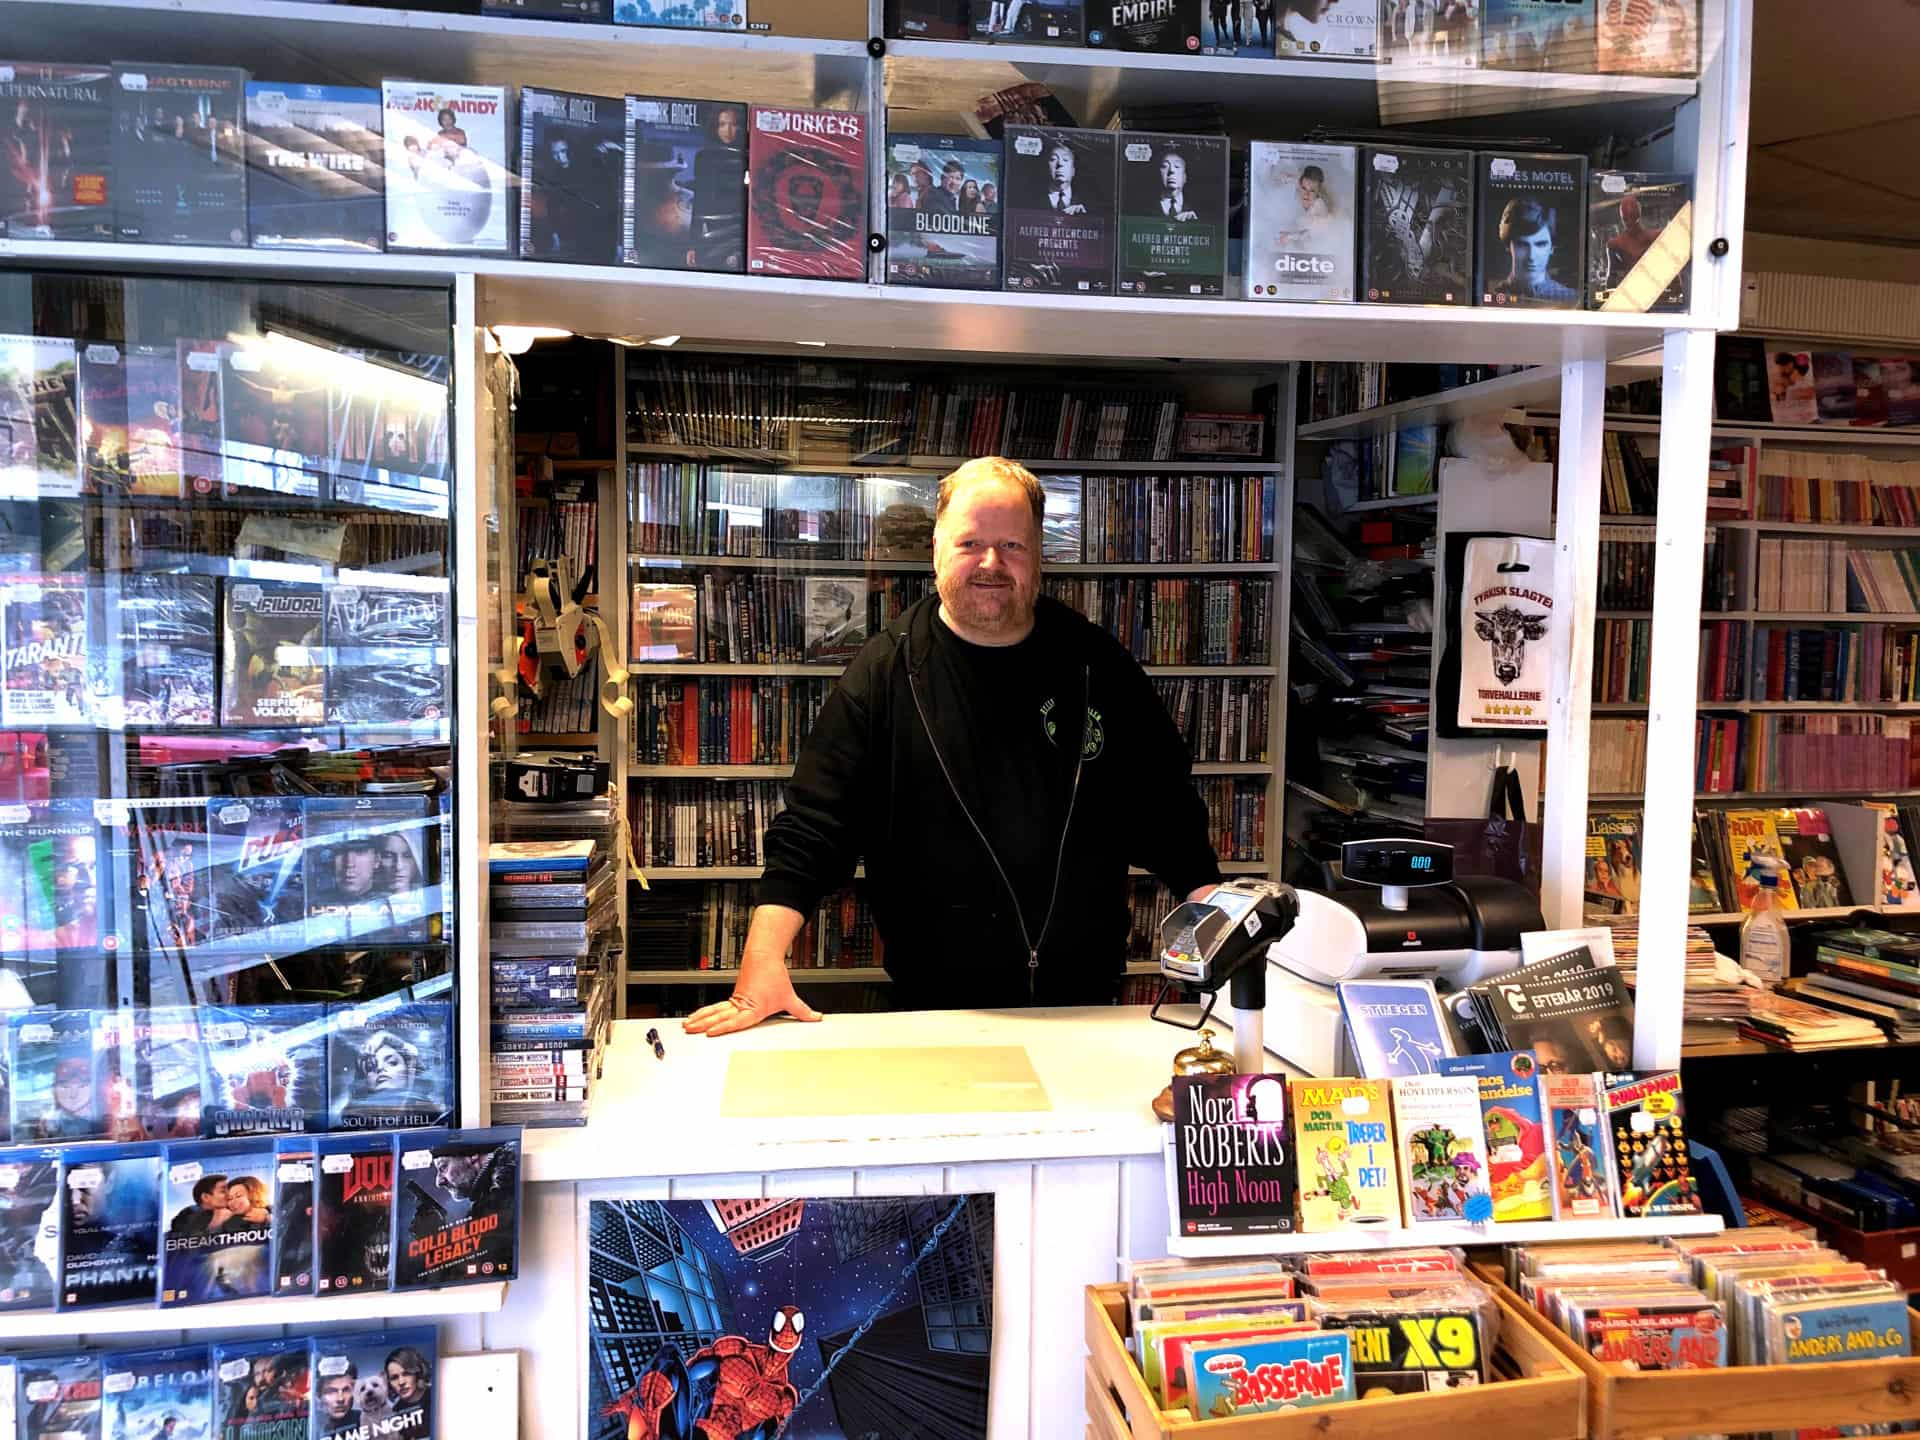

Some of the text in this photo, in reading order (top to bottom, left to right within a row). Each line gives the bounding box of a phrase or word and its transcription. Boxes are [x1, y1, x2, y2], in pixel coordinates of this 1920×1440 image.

[1112, 0, 1176, 26] EMPIRE
[1326, 13, 1377, 25] CROWN
[0, 84, 98, 101] UPERNATURAL
[448, 100, 498, 115] MINDY
[569, 100, 598, 123] ANGEL
[670, 103, 700, 126] ANGEL
[783, 111, 859, 137] MONKEYS
[1401, 159, 1464, 169] KINGS
[1532, 171, 1575, 184] MOTEL
[915, 211, 992, 236] BLOODLINE
[1019, 226, 1049, 238] ALFRED
[1038, 238, 1079, 250] PRESENTS
[1131, 233, 1210, 247] ALFRED HITCHCOCK
[1151, 245, 1190, 256] PRESENTS
[1275, 254, 1335, 273] dicte
[19, 377, 60, 395] THE
[1531, 982, 1614, 1009] EFTERÅR 2019
[1477, 1076, 1504, 1085] aos
[1480, 1082, 1533, 1100] andelse
[1608, 1074, 1679, 1107] RUMSPION
[1189, 1084, 1236, 1126] Nora
[1310, 1110, 1332, 1121] DON
[215, 1107, 305, 1135] SHOCKER
[343, 1114, 431, 1128] SOUTH OF HELL
[1303, 1121, 1344, 1132] MARTIN
[1183, 1122, 1285, 1169] ROBERTS
[343, 1155, 394, 1203] DOO
[1358, 1167, 1388, 1188] DET!
[1186, 1168, 1282, 1217] High Noon
[408, 1213, 499, 1257] COLD BLOOD
[424, 1236, 482, 1269] LEGACY
[1350, 1317, 1477, 1369] GENT X9
[1600, 1333, 1720, 1366] ANDERS AND
[1789, 1335, 1844, 1358] ANDERS
[1846, 1329, 1876, 1352] AND
[1886, 1327, 1905, 1346] Co
[1231, 1353, 1345, 1407] BASSERNE
[373, 1408, 425, 1437] NIGHT
